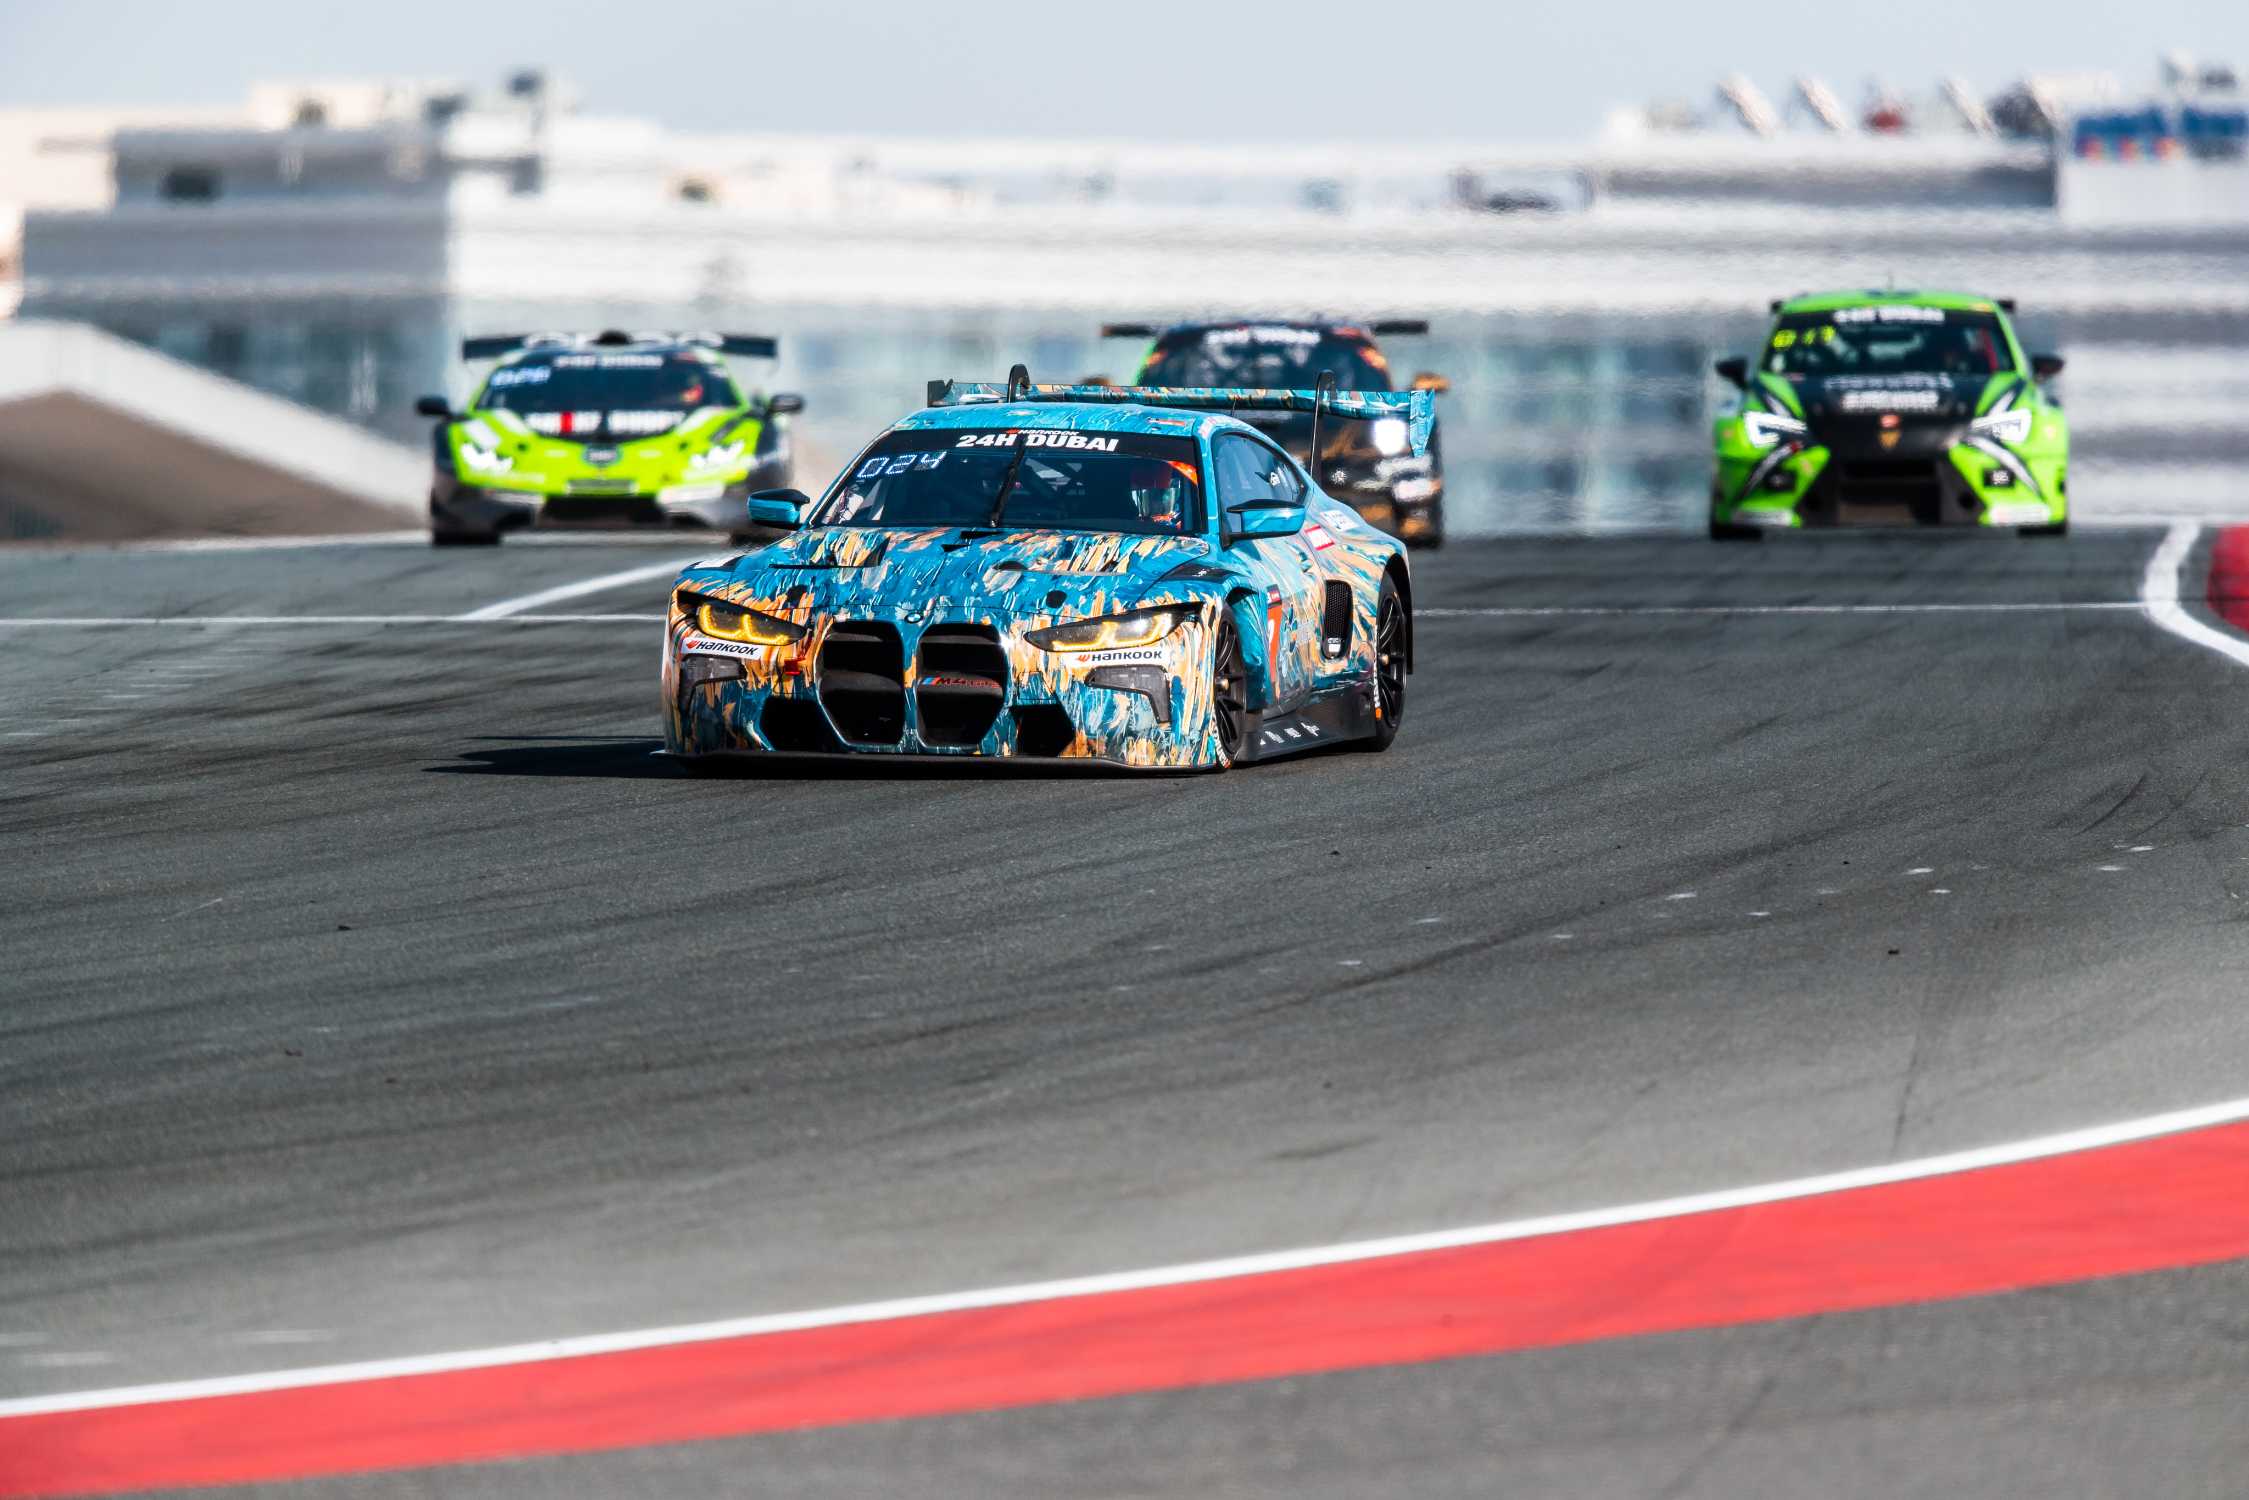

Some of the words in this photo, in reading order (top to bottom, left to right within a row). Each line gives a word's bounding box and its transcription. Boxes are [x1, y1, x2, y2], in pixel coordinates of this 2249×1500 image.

[955, 433, 1018, 448] 24H
[1025, 434, 1119, 452] DUBAI
[857, 451, 947, 478] 024
